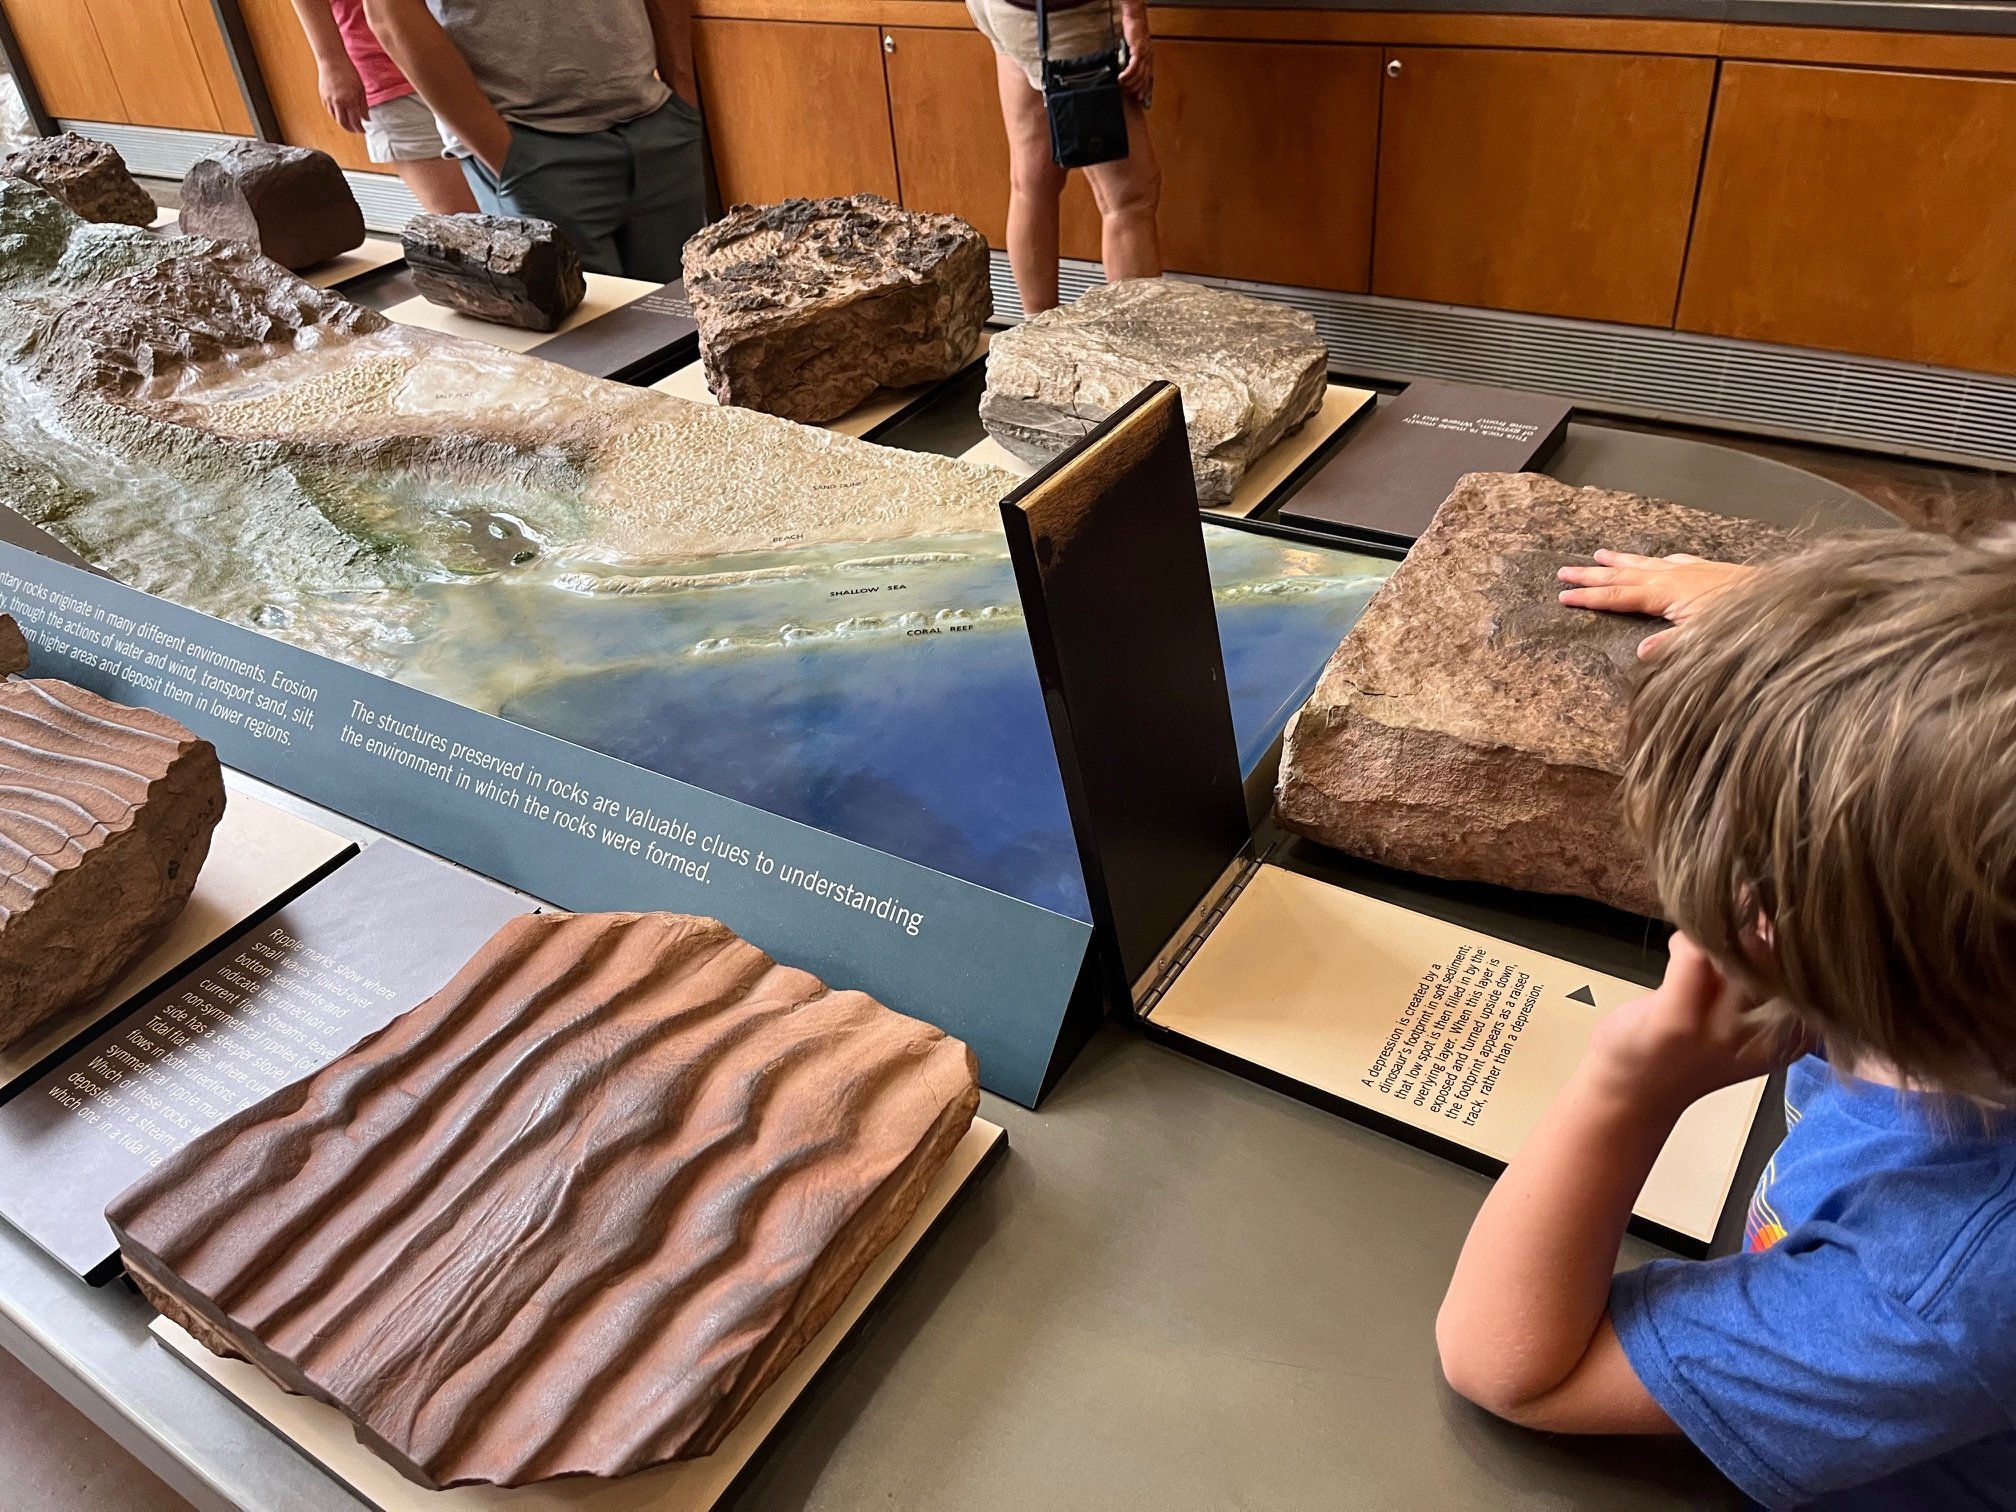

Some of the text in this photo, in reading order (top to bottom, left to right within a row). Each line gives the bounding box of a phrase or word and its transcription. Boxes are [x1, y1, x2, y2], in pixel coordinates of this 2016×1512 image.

[772, 534, 804, 543] BEACH
[830, 586, 880, 597] SHALLOW
[906, 624, 974, 637] CORAL REEF
[0, 570, 22, 592] ntary
[22, 582, 49, 600] rocks
[49, 590, 93, 617] originate
[93, 604, 106, 622] in
[106, 613, 137, 636] many
[137, 621, 186, 653] different
[186, 642, 266, 684] environments.
[271, 670, 318, 702] Erosion
[9, 595, 46, 623] through
[46, 610, 64, 629] the
[64, 621, 101, 644] actions
[101, 633, 116, 649] of
[114, 639, 145, 661] water
[144, 651, 169, 670] and
[168, 659, 198, 685] wind,
[201, 670, 255, 704] transport
[255, 694, 288, 720] sand,
[291, 706, 314, 731] silt,
[37, 630, 71, 655] higher
[70, 647, 99, 667] areas
[98, 658, 122, 676] and
[121, 664, 163, 693] deposit
[163, 680, 194, 706] them
[195, 692, 208, 712] in
[209, 698, 244, 725] lower
[243, 716, 291, 746] regions.
[340, 724, 711, 885] the environment in which the rocks were formed.
[351, 699, 924, 936] The structures preserved in rocks are valuable clues to understanding
[216, 964, 343, 1037] indicate the direction of
[234, 952, 351, 1018] bottom sediments and
[251, 942, 374, 1009] small waves flowed over
[268, 928, 396, 1000] Ripple marks show where
[145, 1014, 176, 1036] Tidal
[167, 1029, 192, 1048] flat
[214, 1059, 248, 1082] where
[162, 1004, 188, 1022] side
[184, 1015, 208, 1034] has
[204, 1029, 216, 1039] a
[213, 1034, 256, 1060] steeper
[181, 991, 319, 1073] non-symmetrical ripples (on
[199, 979, 337, 1060] current flow. Streams leave
[1361, 963, 1442, 1088] A depression is created by a
[1394, 948, 1487, 1100] that low spot is then filled in by the
[1403, 1009, 1434, 1047] footprint
[1424, 1000, 1439, 1011] in
[1433, 983, 1449, 1001] soft
[1413, 958, 1500, 1107] overlying layer. When this layer is
[1430, 964, 1519, 1114] exposed and turned upside down,
[1444, 1101, 1463, 1120] the
[1454, 1058, 1486, 1101] footprint
[1480, 1020, 1505, 1058] appears
[1499, 1007, 1512, 1020] as
[1509, 971, 1530, 1000] raised
[88, 1055, 192, 1129] Which of these rocks
[106, 1044, 173, 1087] symmetrical
[166, 1082, 200, 1107] ripple
[197, 1102, 230, 1123] mark
[125, 1028, 155, 1051] flows
[150, 1043, 166, 1058] in
[161, 1050, 188, 1072] both
[184, 1067, 237, 1105] directions,
[1462, 984, 1545, 1127] track, rather than a depression.
[48, 1086, 162, 1168] which one in a tidal fla
[67, 1071, 123, 1109] deposited
[114, 1102, 131, 1117] in
[126, 1112, 140, 1122] a
[135, 1118, 176, 1147] stream
